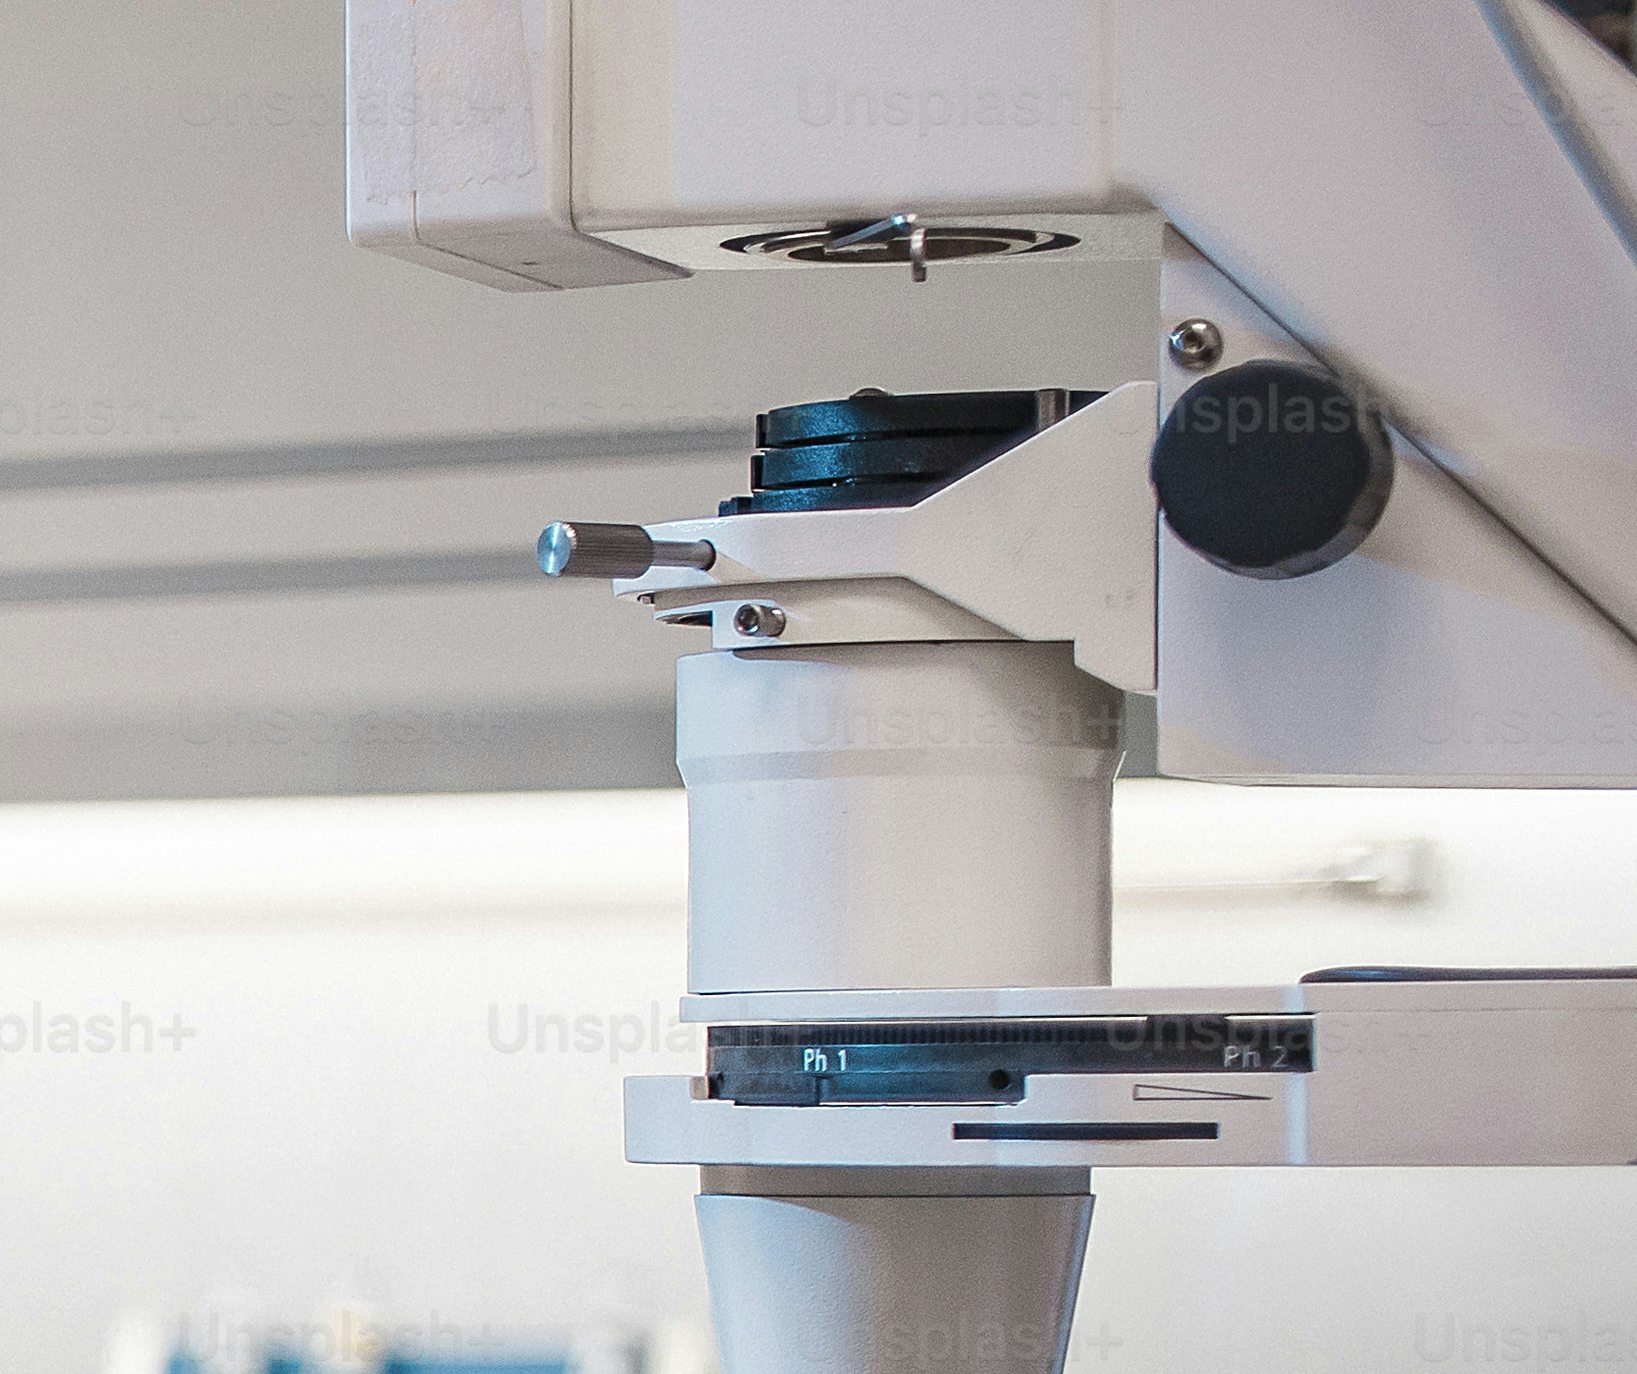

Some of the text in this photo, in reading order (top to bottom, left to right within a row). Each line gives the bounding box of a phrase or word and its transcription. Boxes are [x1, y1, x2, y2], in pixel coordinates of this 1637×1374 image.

[804, 1047, 847, 1072] Ph 1
[1271, 1045, 1289, 1069] 2
